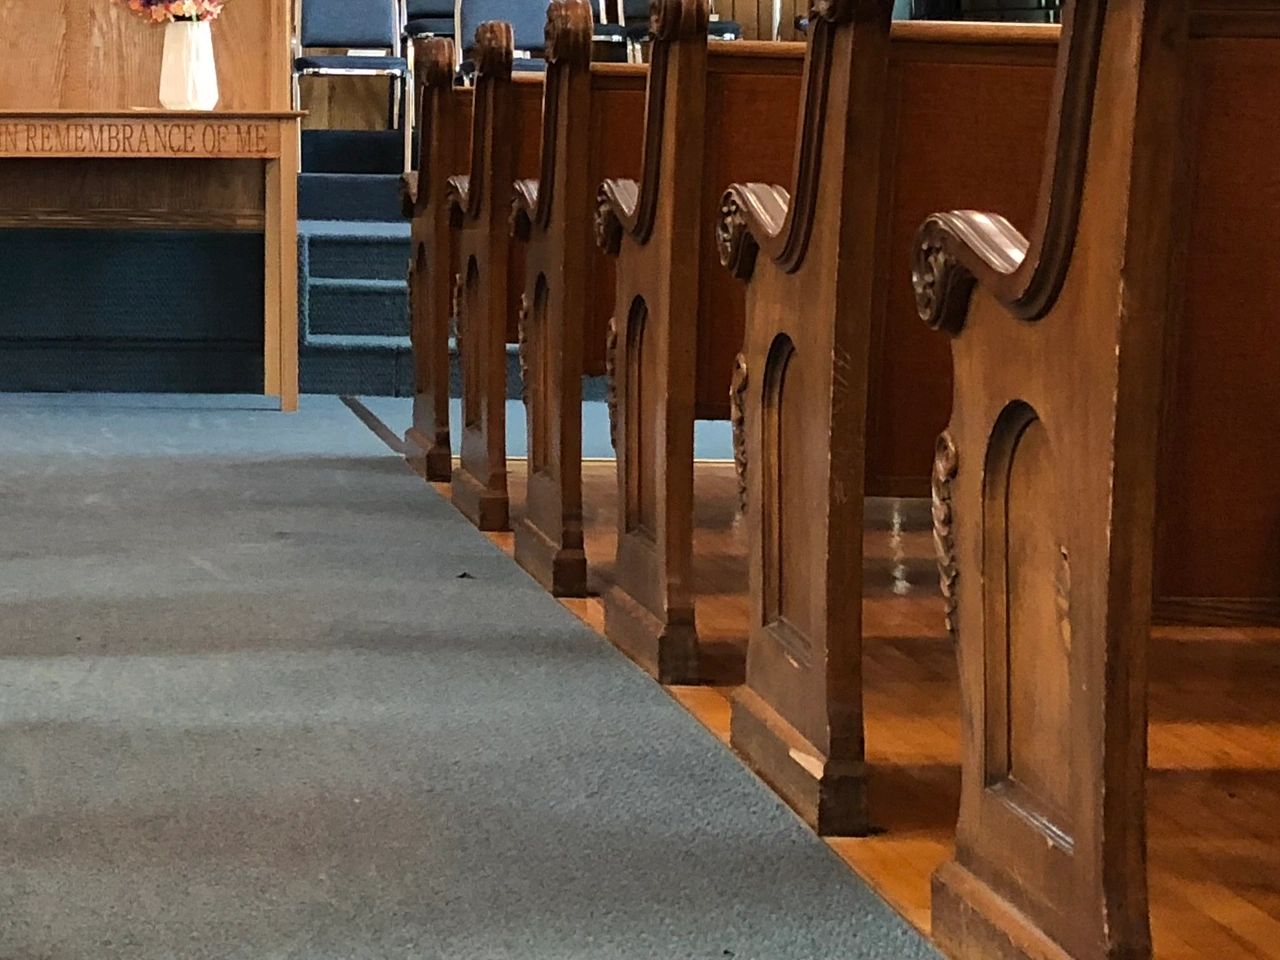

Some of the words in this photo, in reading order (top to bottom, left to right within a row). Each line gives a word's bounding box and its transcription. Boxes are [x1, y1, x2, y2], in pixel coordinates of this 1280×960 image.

[26, 123, 196, 153] REMEMBRANCE
[201, 123, 228, 153] OF
[236, 123, 268, 153] ME
